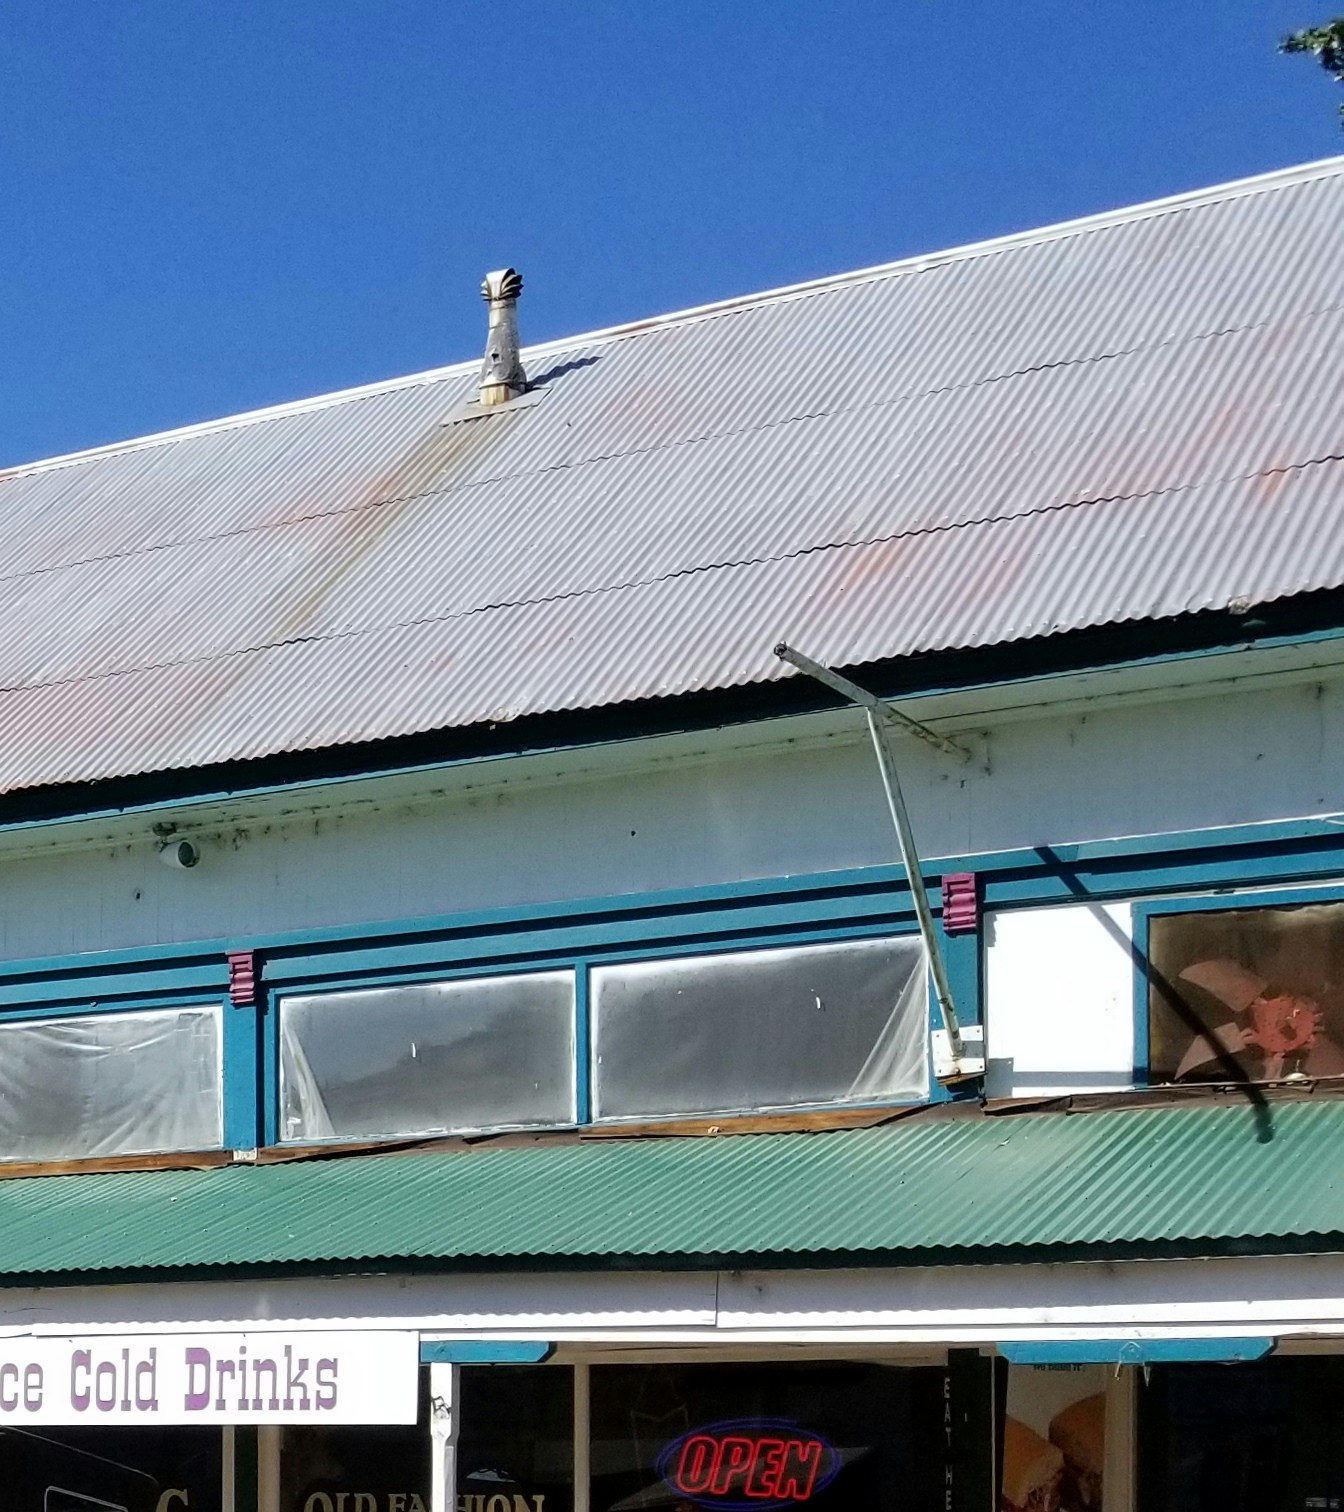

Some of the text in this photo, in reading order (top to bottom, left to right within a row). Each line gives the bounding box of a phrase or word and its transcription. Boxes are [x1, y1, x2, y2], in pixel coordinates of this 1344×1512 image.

[70, 1347, 159, 1412] Cold
[184, 1345, 338, 1411] Drinks
[677, 1434, 823, 1500] OPEN
